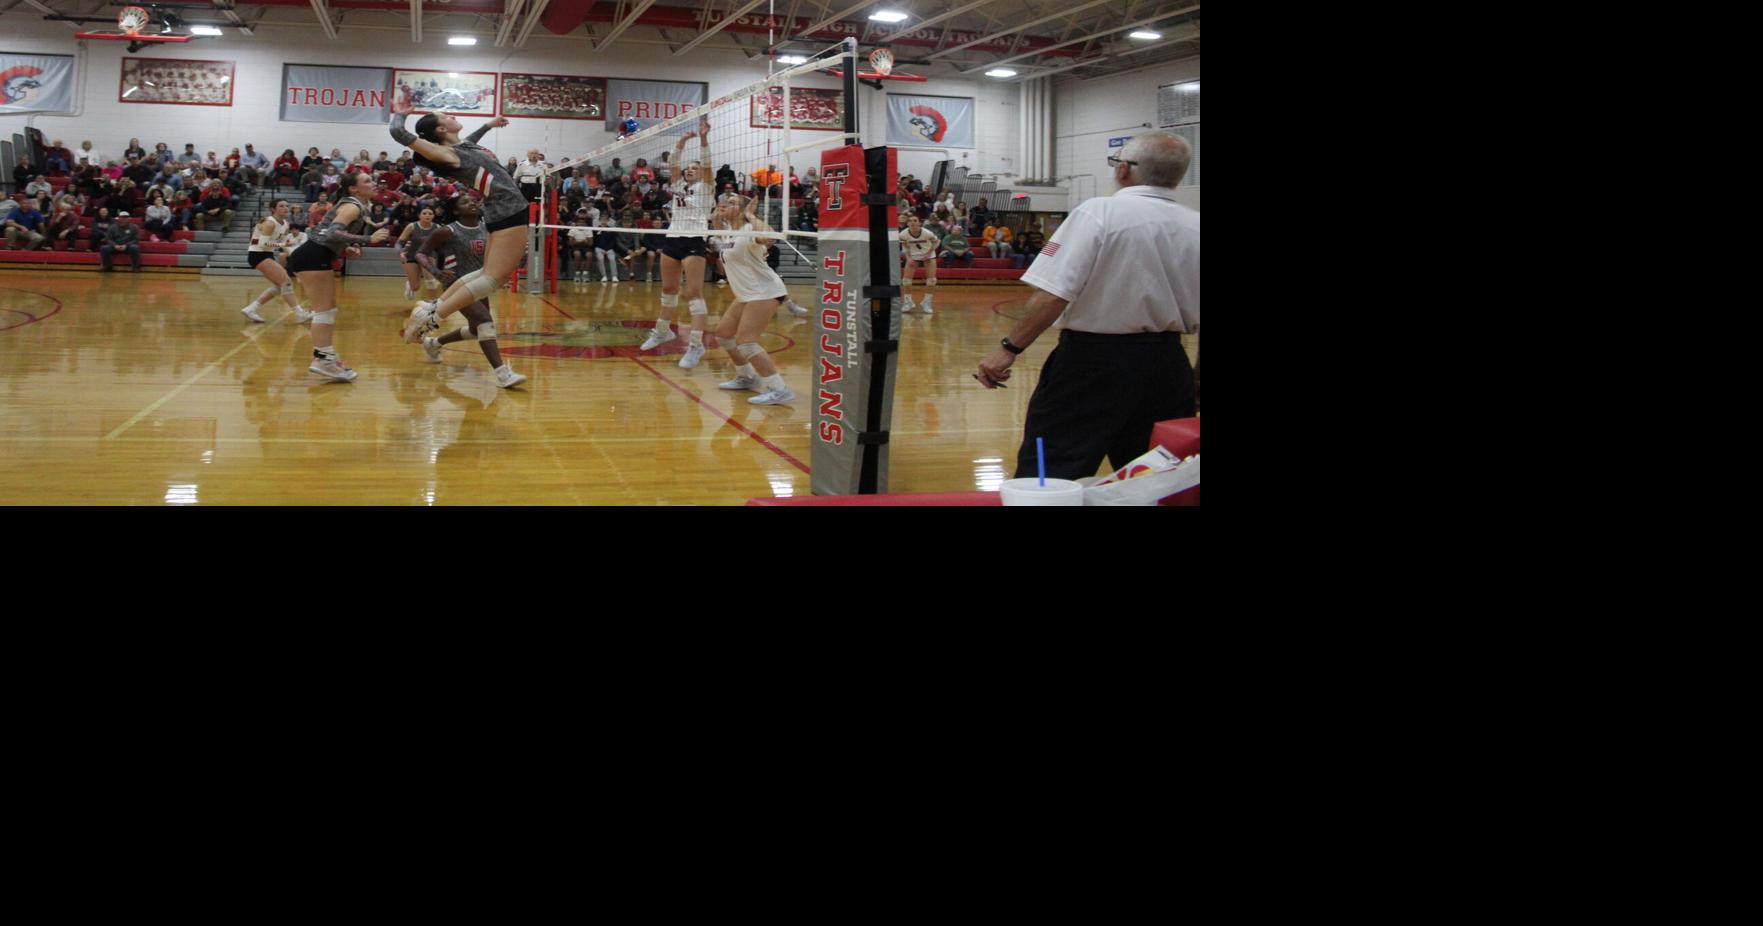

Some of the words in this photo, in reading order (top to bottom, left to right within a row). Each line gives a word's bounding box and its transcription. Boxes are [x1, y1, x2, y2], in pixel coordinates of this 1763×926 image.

[691, 10, 802, 30] TUSTALL
[288, 86, 386, 108] TROJAN
[819, 250, 846, 446] TROJANS
[846, 289, 859, 369] TUNSTALL
